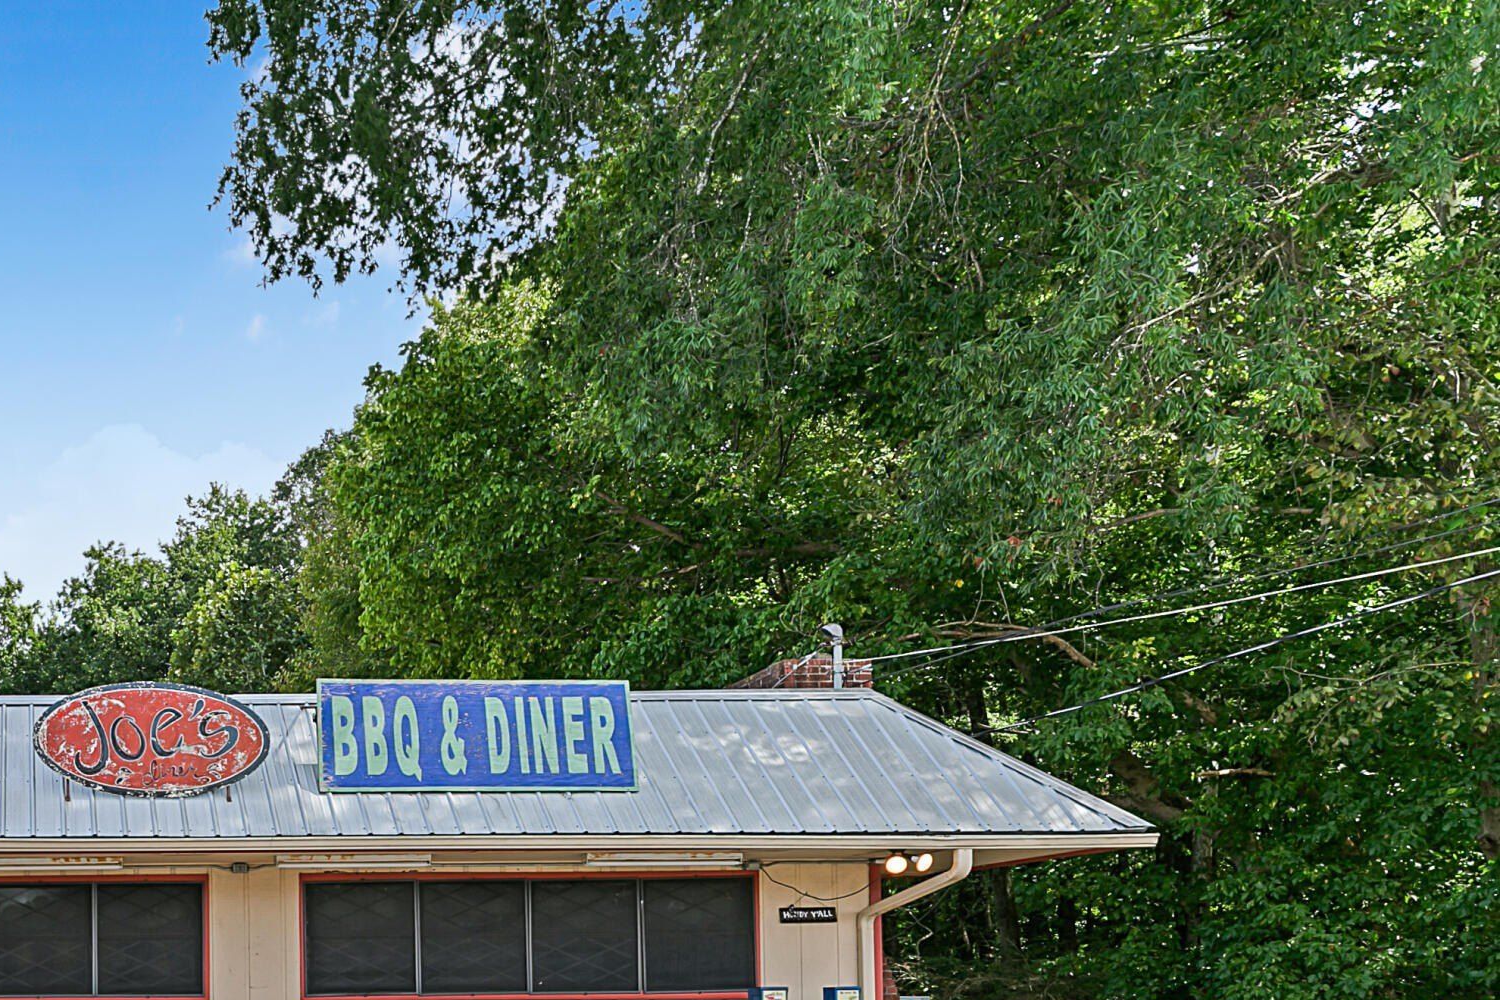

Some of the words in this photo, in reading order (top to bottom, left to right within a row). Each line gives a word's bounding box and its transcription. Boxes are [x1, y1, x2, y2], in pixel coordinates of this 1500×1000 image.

[333, 696, 424, 783] BBQ
[441, 696, 469, 775] &
[486, 695, 623, 775] DINER
